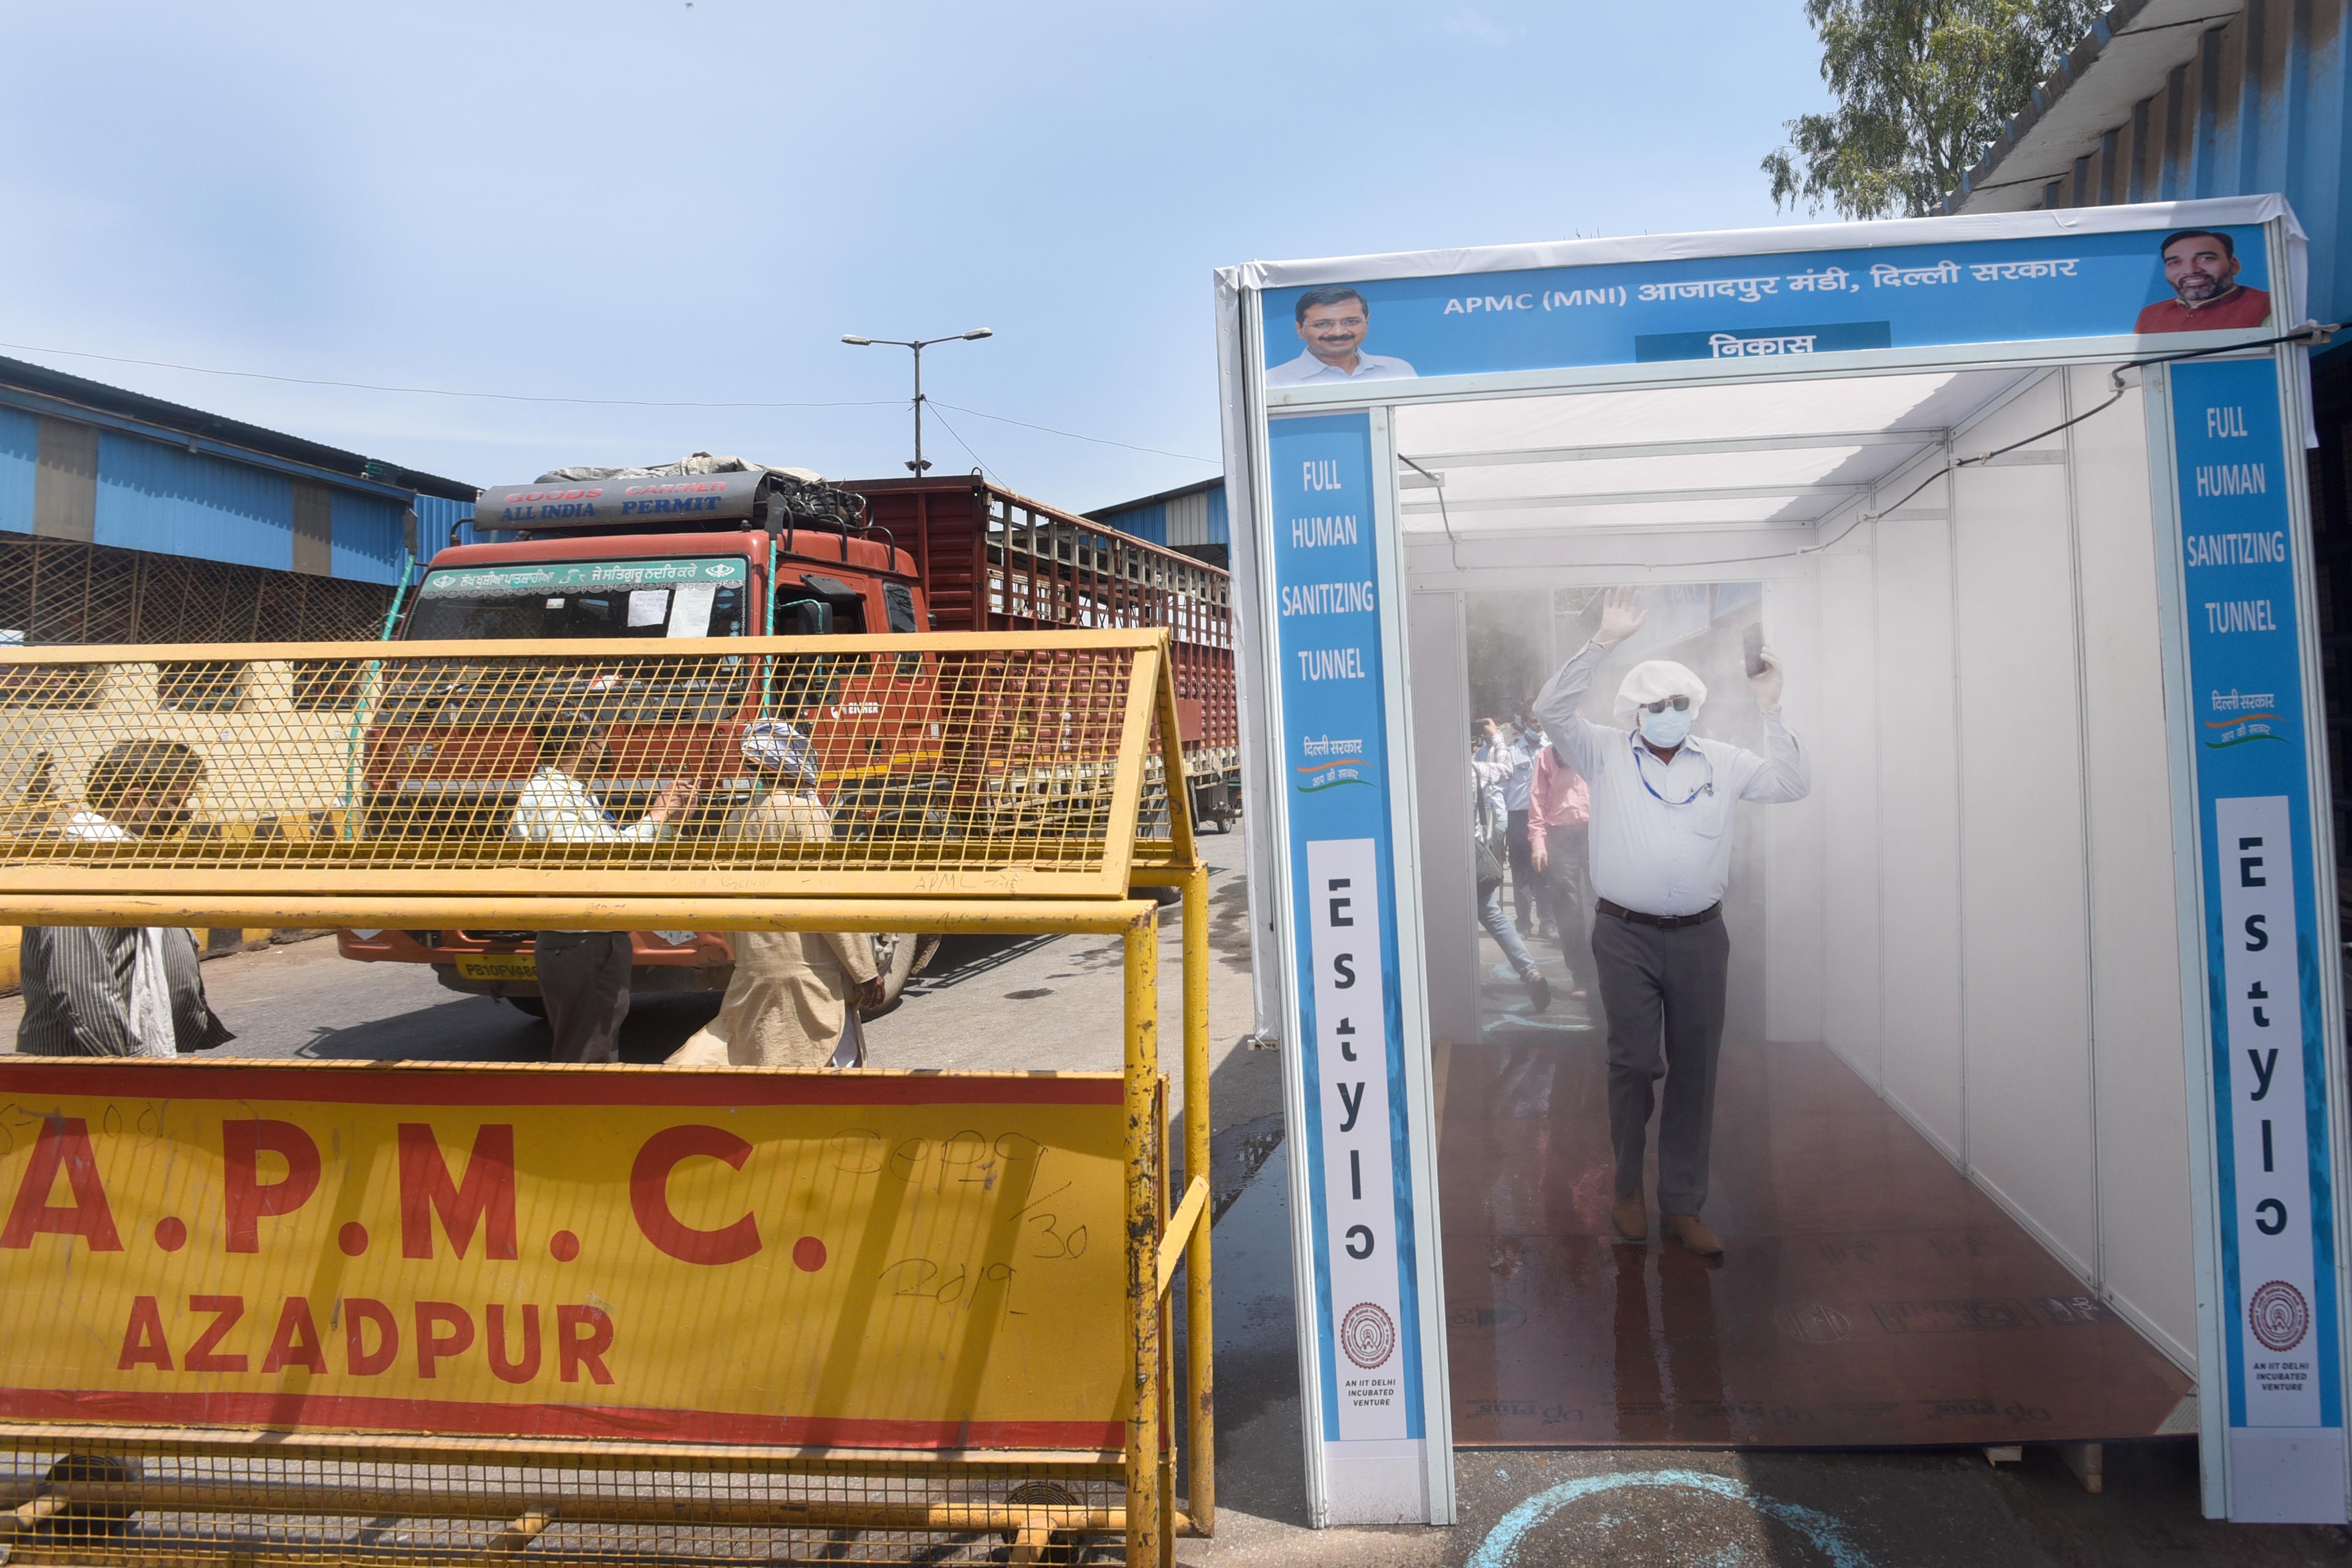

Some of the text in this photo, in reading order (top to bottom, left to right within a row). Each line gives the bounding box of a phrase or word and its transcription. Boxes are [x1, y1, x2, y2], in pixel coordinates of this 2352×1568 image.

[1443, 259, 2080, 314] APMC (MNI) आजादपुर मंडी, दिल्ली सरकार
[1709, 333, 1816, 358] निकास
[2207, 406, 2248, 438] FULL
[1303, 459, 1342, 491] FULL
[2196, 463, 2265, 497] HUMAN
[505, 481, 726, 503] GOODS CARRIER
[501, 496, 721, 521] ALL INDIA PERMIT
[1292, 514, 1357, 548] HUMAN
[2187, 531, 2285, 567] SANITIZING
[1282, 581, 1374, 616] SANITIZING
[2205, 599, 2276, 633] TUNNEL
[1298, 648, 1365, 681] TUNNEL
[2212, 688, 2274, 711] दिल्ली सरकार
[1303, 734, 1363, 756] दिल्ली सरकार
[0, 1118, 827, 1272] A.P.M.C.
[117, 1295, 616, 1385] AZADPUR
[2256, 1373, 2308, 1381] INCUBATED
[2261, 1383, 2304, 1391] VENTURE
